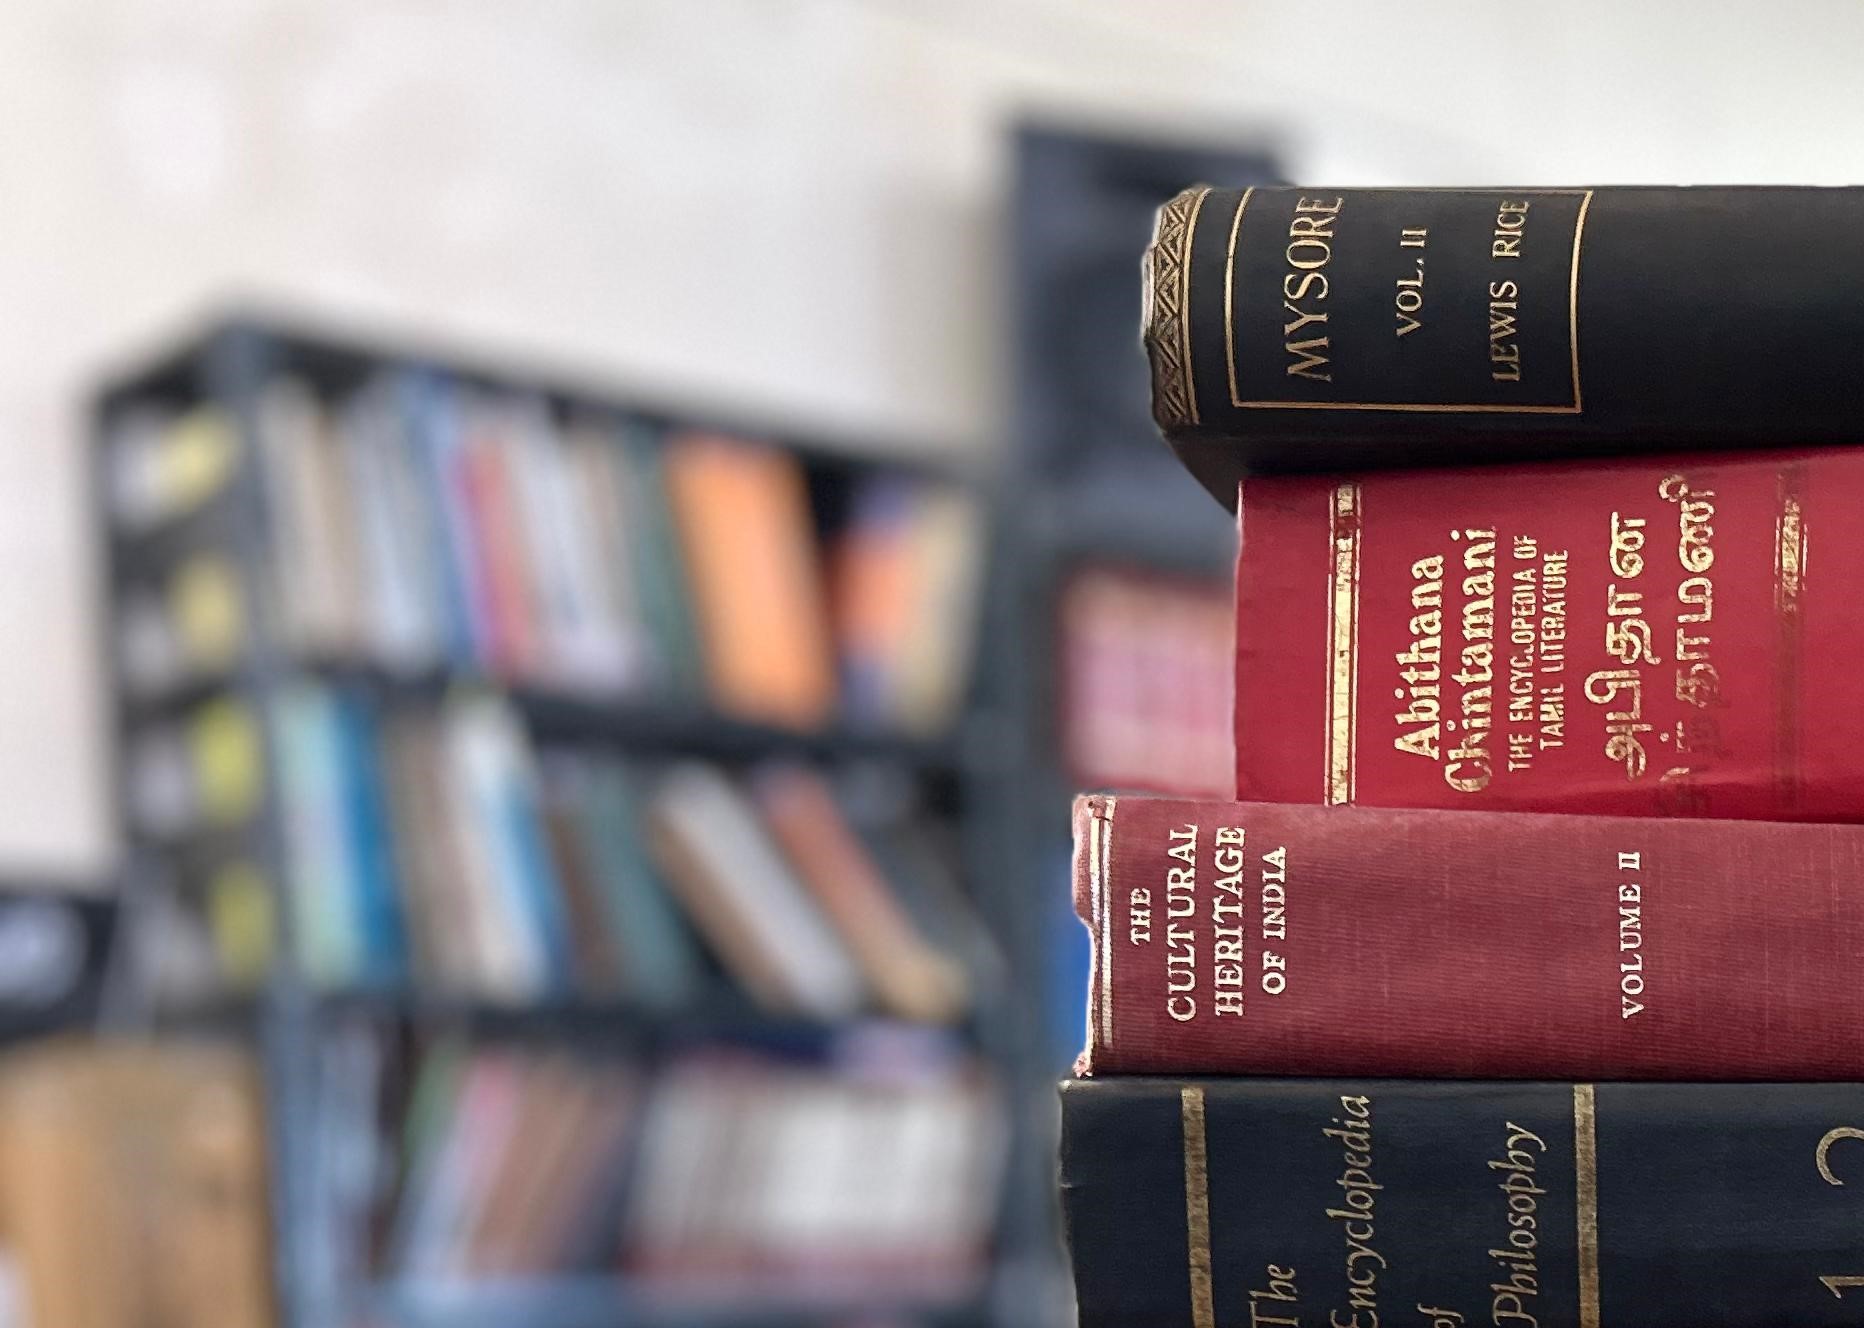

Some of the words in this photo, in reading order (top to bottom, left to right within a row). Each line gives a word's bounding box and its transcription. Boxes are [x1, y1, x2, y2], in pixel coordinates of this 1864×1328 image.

[1401, 226, 1428, 248] II
[1491, 199, 1530, 259] RICE
[1283, 194, 1344, 383] MYSORE
[1396, 258, 1426, 337] VOL.
[1488, 280, 1521, 382] LEWIS
[1512, 534, 1538, 560] OF
[1541, 548, 1569, 677] LITERATURE
[1394, 554, 1445, 761] Abithana
[1444, 525, 1498, 793] Chintamani
[1507, 735, 1535, 773] THE
[1539, 683, 1565, 752] TAMIL
[1261, 845, 1288, 941] INDIA
[1617, 850, 1642, 871] II
[1129, 887, 1152, 946] THE
[1166, 823, 1199, 1023] CULTURAL
[1213, 825, 1246, 1018] HERITAGE
[1617, 882, 1645, 1019] VOLUME
[1261, 949, 1288, 996] OF
